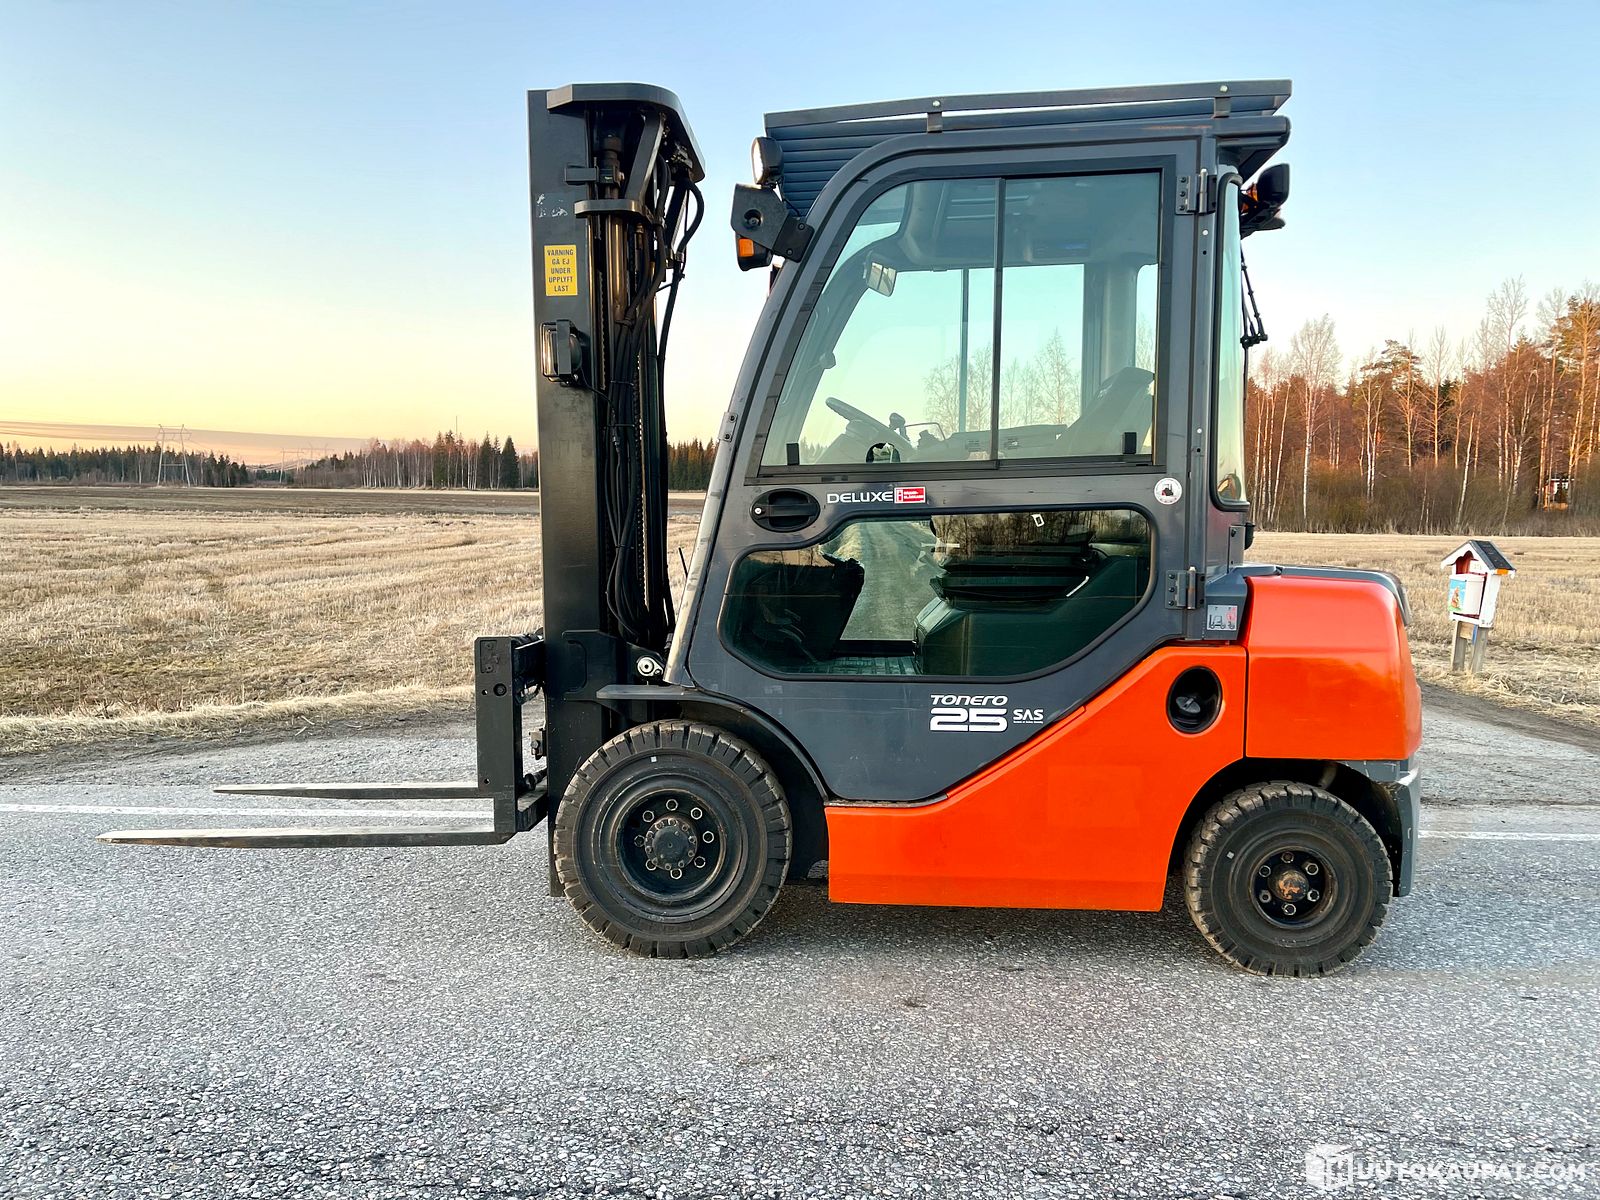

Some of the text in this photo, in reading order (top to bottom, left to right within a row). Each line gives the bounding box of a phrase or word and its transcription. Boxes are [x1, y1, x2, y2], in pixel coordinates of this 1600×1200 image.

[550, 267, 571, 275] UNDER
[826, 491, 894, 503] DELUXE
[930, 694, 1008, 706] TONERO
[930, 707, 1044, 732] 25 SAS
